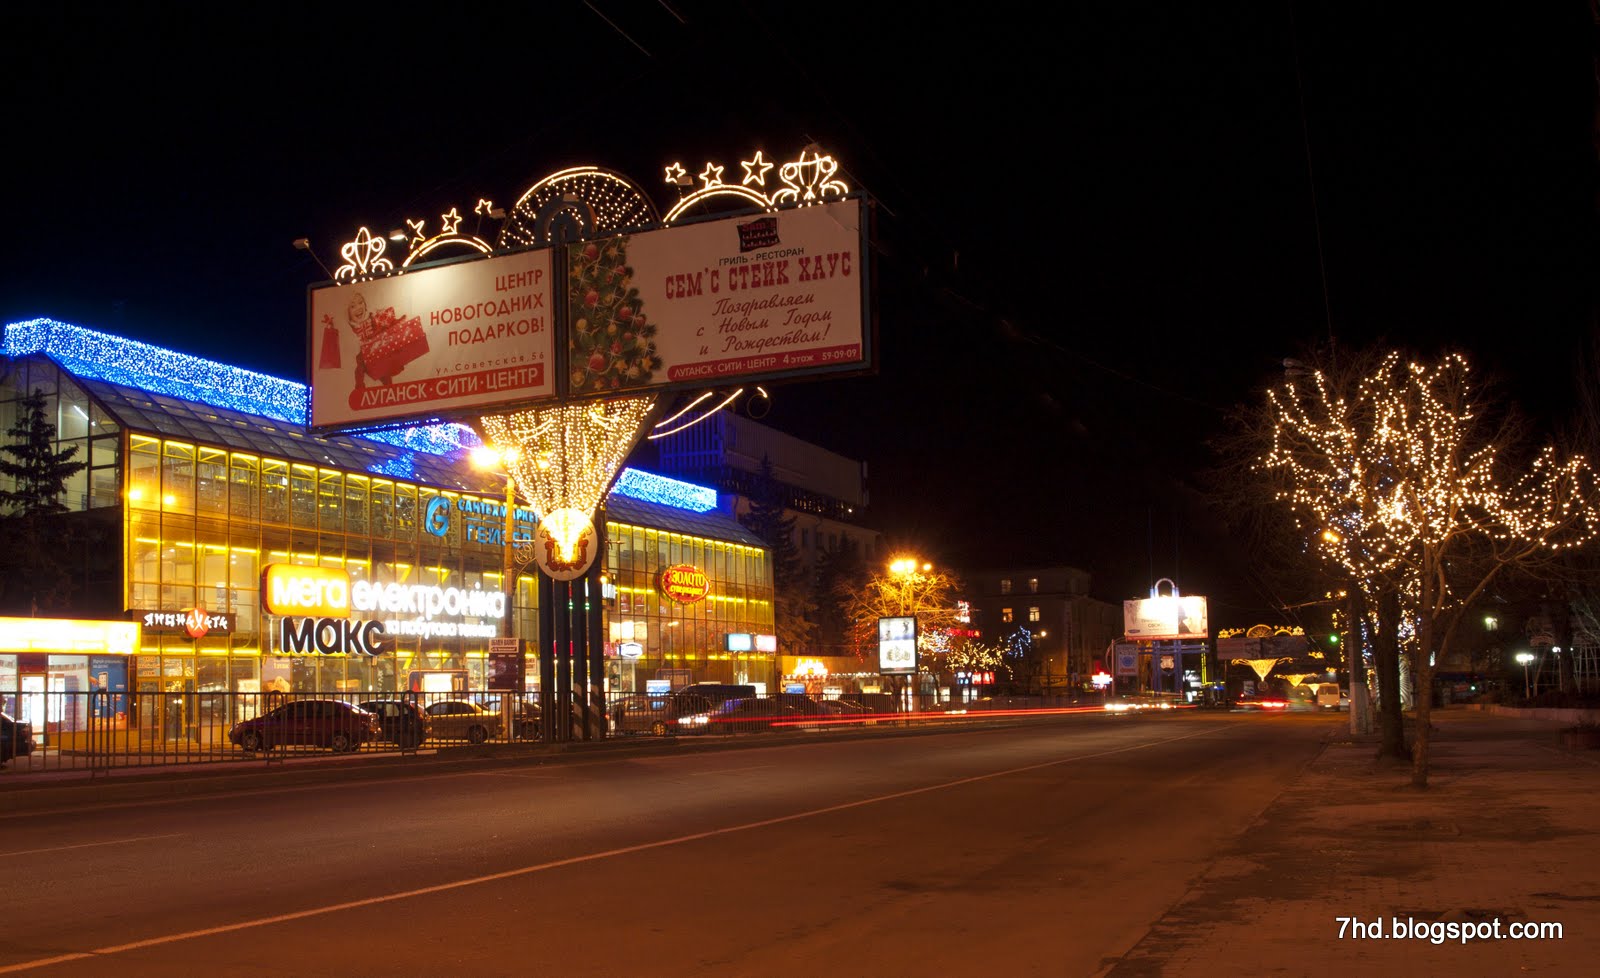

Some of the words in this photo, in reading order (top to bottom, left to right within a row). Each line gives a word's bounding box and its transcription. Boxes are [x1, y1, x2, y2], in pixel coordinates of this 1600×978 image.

[719, 254, 748, 267] ГРИЛЬ
[755, 246, 805, 263] РЕСТОРАН
[495, 269, 543, 292] ЦЕНТР
[665, 267, 720, 300] СЕМ'С
[728, 260, 790, 292] СТЕЙК
[798, 251, 851, 283] ХАУС
[430, 293, 544, 326] НОВОГОДНИХ
[712, 292, 814, 317] Поздравляем
[448, 317, 544, 347] ПОДАРКОВ!
[696, 326, 705, 337] с
[719, 316, 769, 335] Новым
[783, 308, 832, 330] Годом
[699, 344, 710, 356] и
[721, 324, 831, 355] Рождеством!
[674, 364, 713, 379] ЛУГАНСК
[718, 361, 742, 374] СИТИ
[747, 357, 777, 373] ЦЕНТР
[782, 353, 790, 364] 4
[791, 353, 814, 365] этаж
[360, 383, 428, 407] ЛУГАНСК
[436, 376, 478, 397] СИТИ
[486, 368, 539, 391] ЦЕНТР
[671, 570, 705, 587] ЗОЛОТО
[273, 577, 347, 608] мега
[351, 580, 506, 620] електроніка
